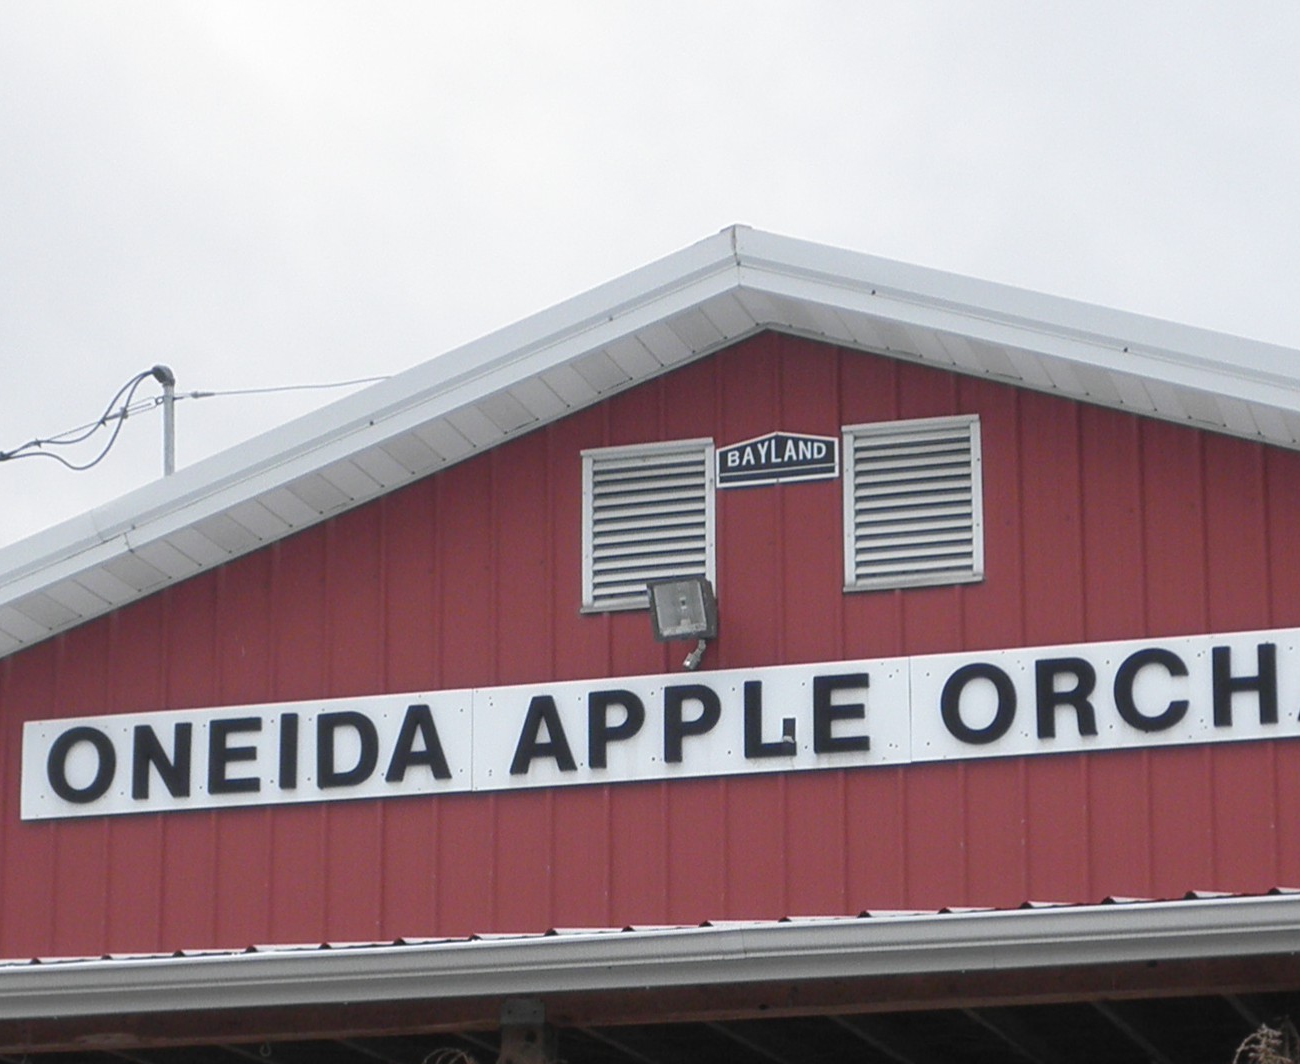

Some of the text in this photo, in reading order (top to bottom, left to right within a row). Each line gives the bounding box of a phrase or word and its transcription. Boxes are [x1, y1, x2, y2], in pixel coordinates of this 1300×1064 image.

[727, 438, 827, 467] BAYLAND
[46, 703, 452, 804] ONEIDA
[509, 672, 870, 775] APPLE
